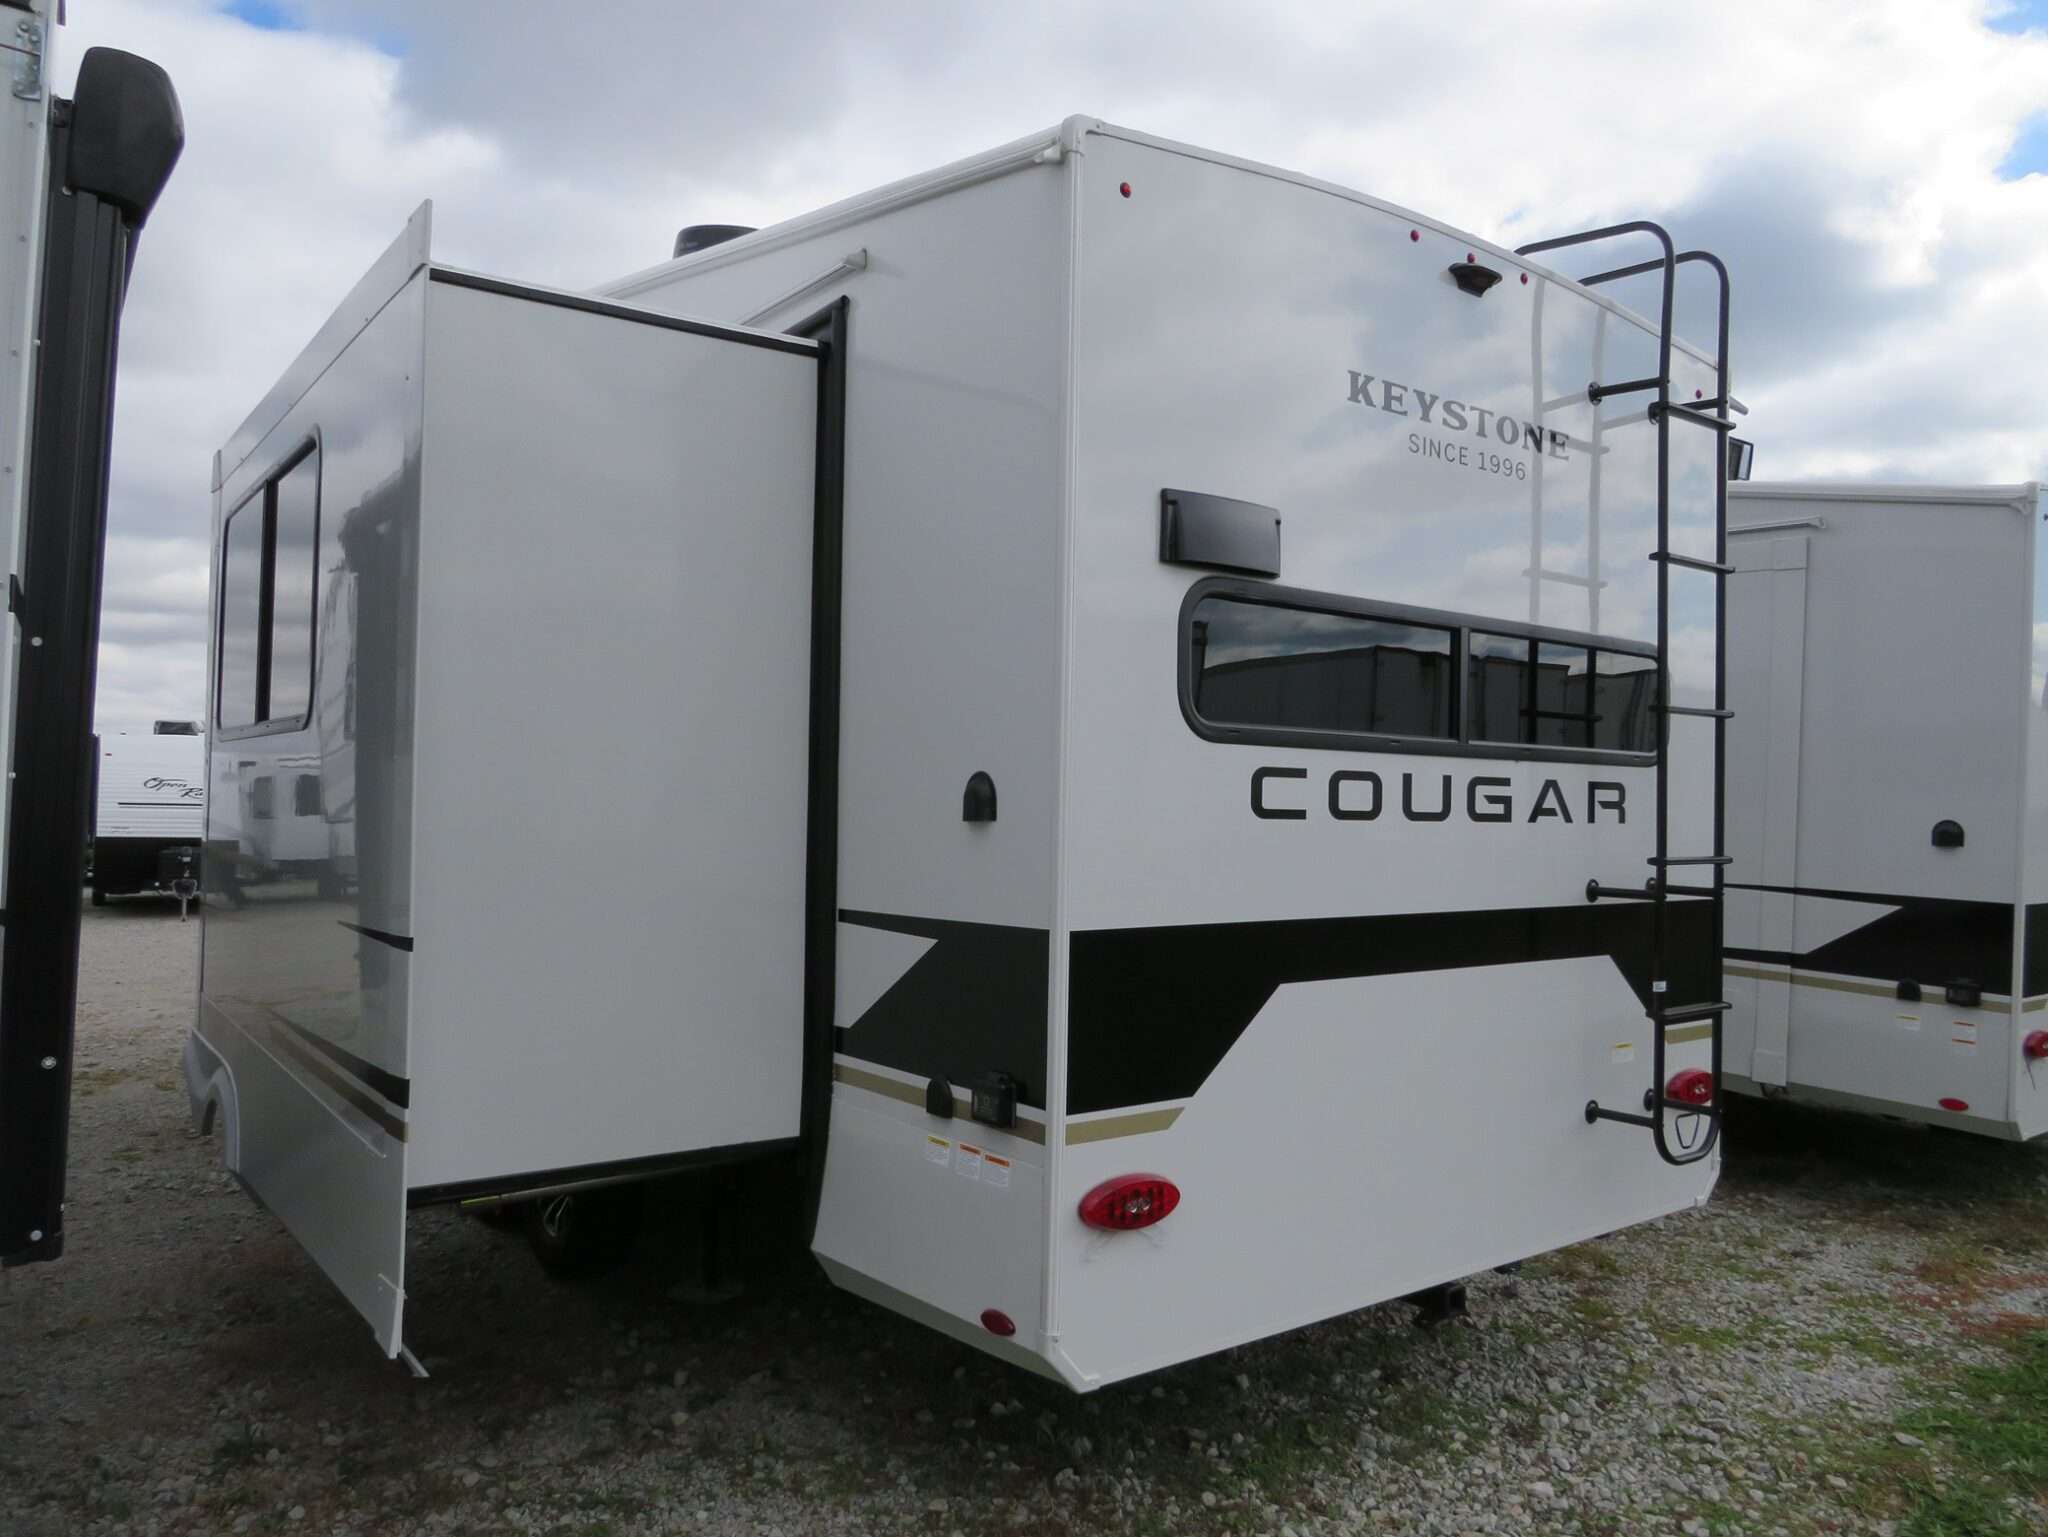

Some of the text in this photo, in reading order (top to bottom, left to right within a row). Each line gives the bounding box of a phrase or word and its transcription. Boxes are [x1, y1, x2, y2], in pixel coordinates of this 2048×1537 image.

[1347, 369, 1570, 460] KEYSTONE
[1408, 433, 1526, 481] SINCE 1996
[143, 777, 188, 791] Open
[1250, 766, 1627, 824] COUGAR
